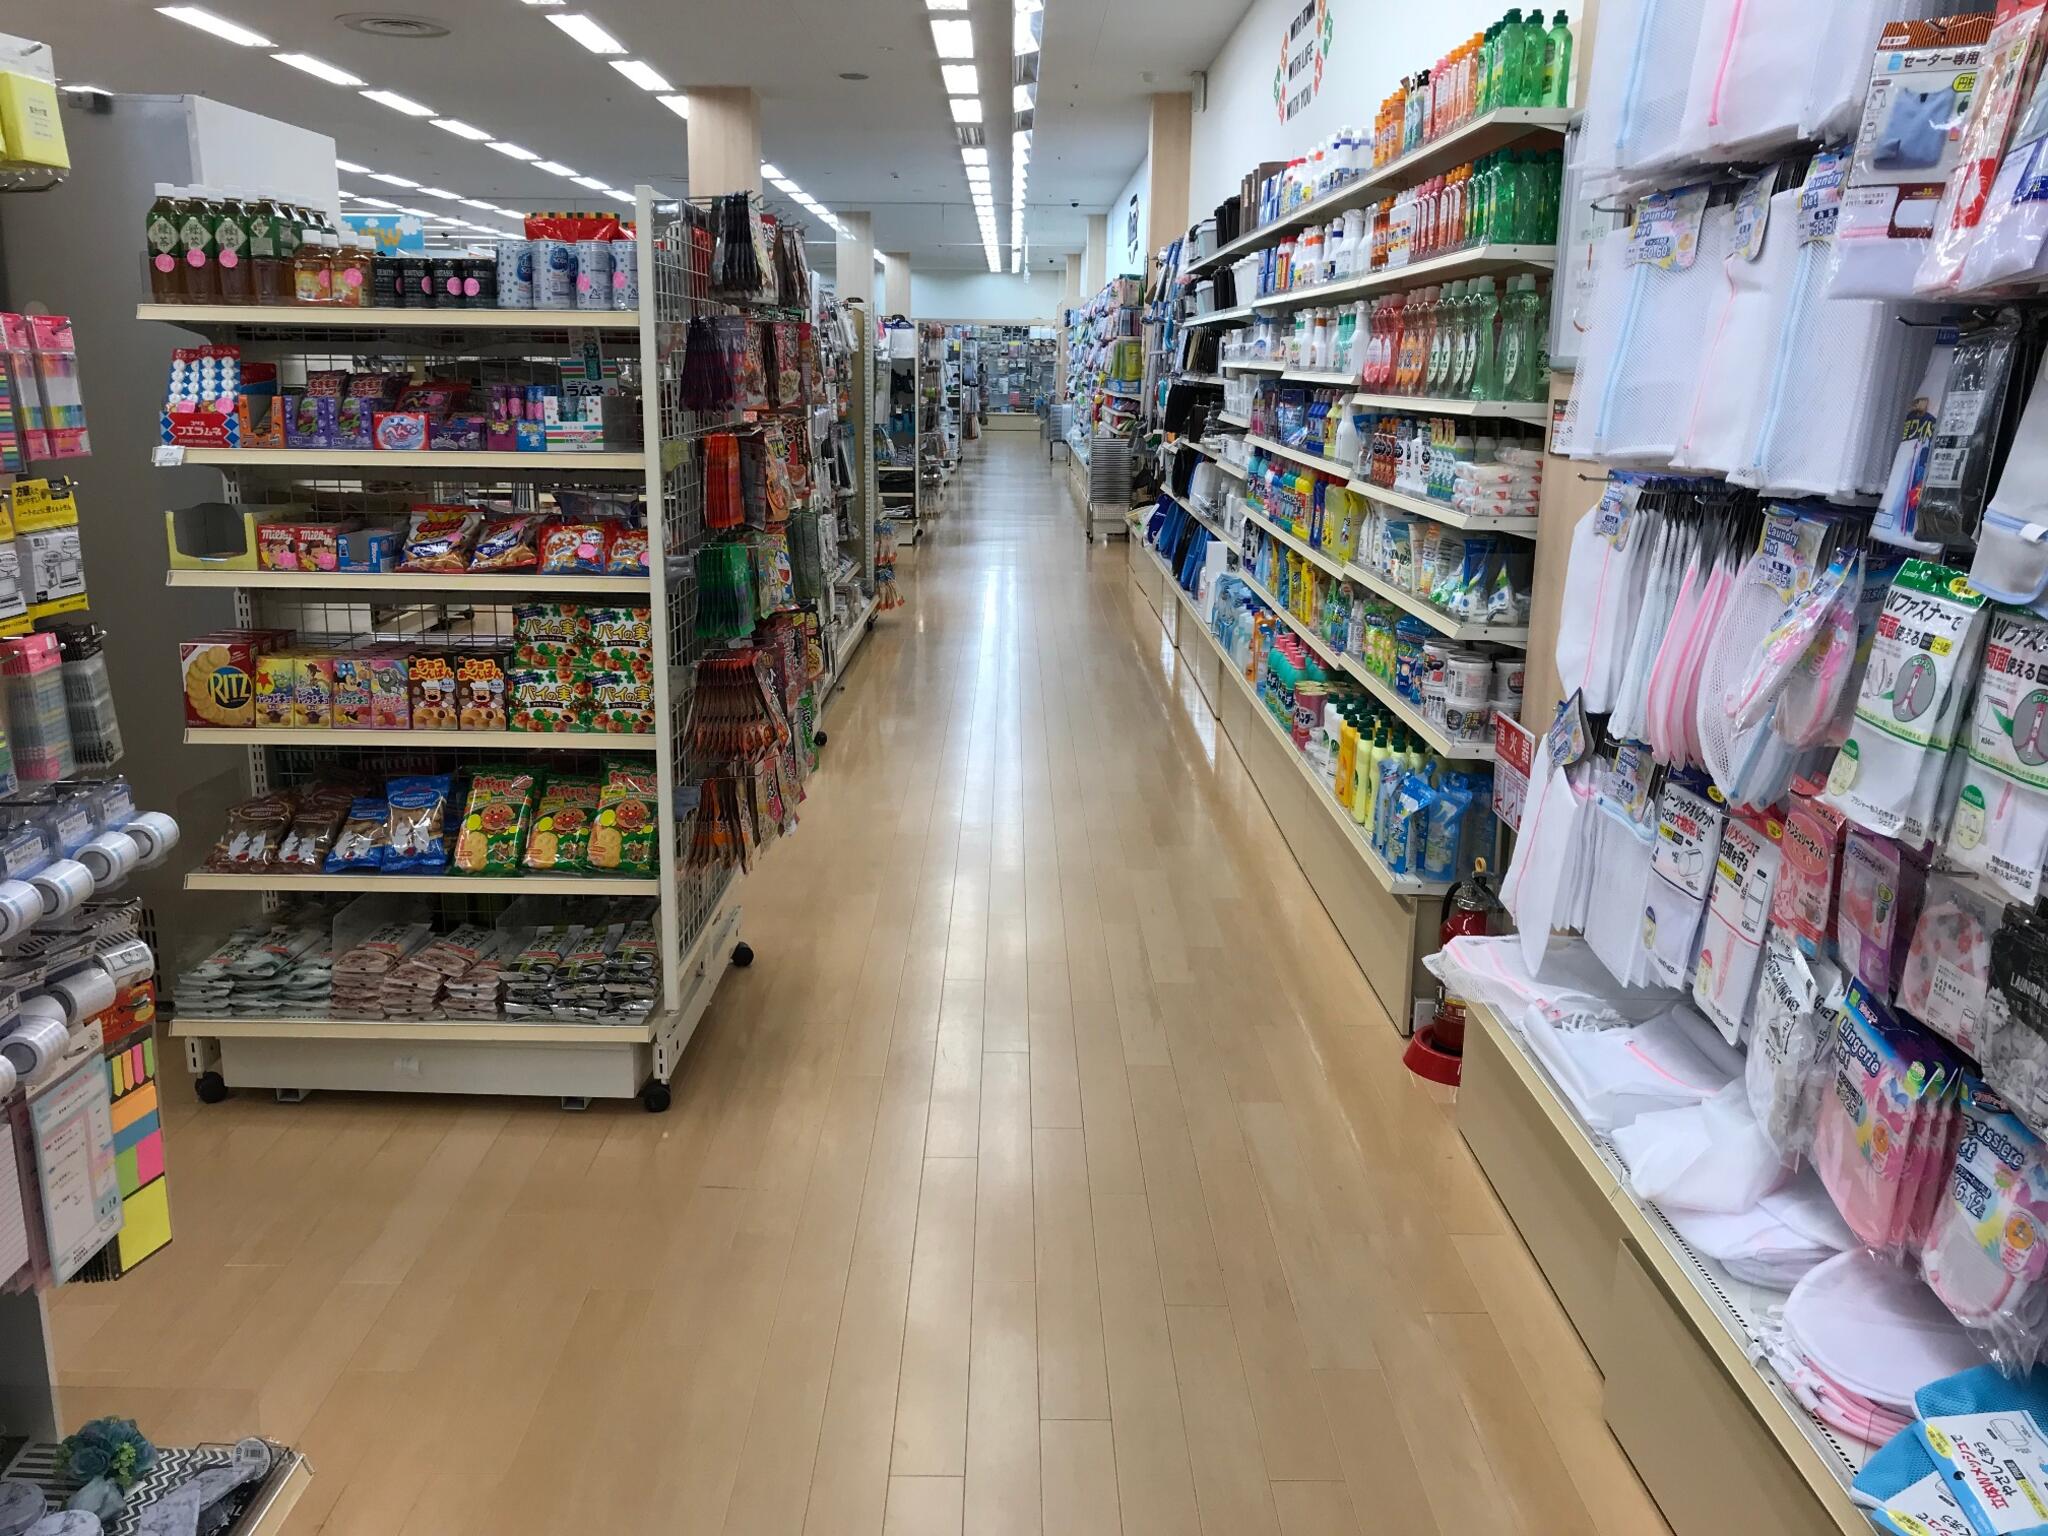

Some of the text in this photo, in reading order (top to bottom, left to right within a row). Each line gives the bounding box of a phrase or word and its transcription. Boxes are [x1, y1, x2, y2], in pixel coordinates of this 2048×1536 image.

[1290, 15, 1302, 41] WITH
[1289, 41, 1314, 81] WITH LIFE
[1904, 52, 1980, 68] セーター専用
[1287, 84, 1312, 121] WITH YOU
[1801, 192, 1819, 209] Net
[1639, 209, 1677, 223] Laundry
[1636, 224, 1652, 238] Net
[567, 385, 605, 396] ラムネ
[176, 427, 223, 436] フエラムネ
[261, 529, 293, 542] Milky
[301, 530, 332, 543] Milky
[1767, 523, 1800, 545] Laundry
[1763, 539, 1779, 557] Net
[1884, 591, 1965, 632] Wファスナーで
[524, 618, 578, 637] パイの実
[597, 623, 651, 641] パイの実
[1877, 615, 1921, 648] 両面使える
[416, 658, 446, 669] チョコ
[466, 658, 496, 669] チョコ
[1986, 643, 2036, 682] 両面使える
[210, 672, 252, 704] RITZ
[520, 683, 574, 702] パイの実
[600, 684, 652, 702] パイの実
[1497, 721, 1530, 765] 消火器
[1664, 789, 1715, 827] シーツやタオルケット
[1786, 819, 1825, 861] ランジェリーネット
[1839, 1017, 1881, 1078] Lingerie
[1974, 1441, 2018, 1497] やさしく洗う
